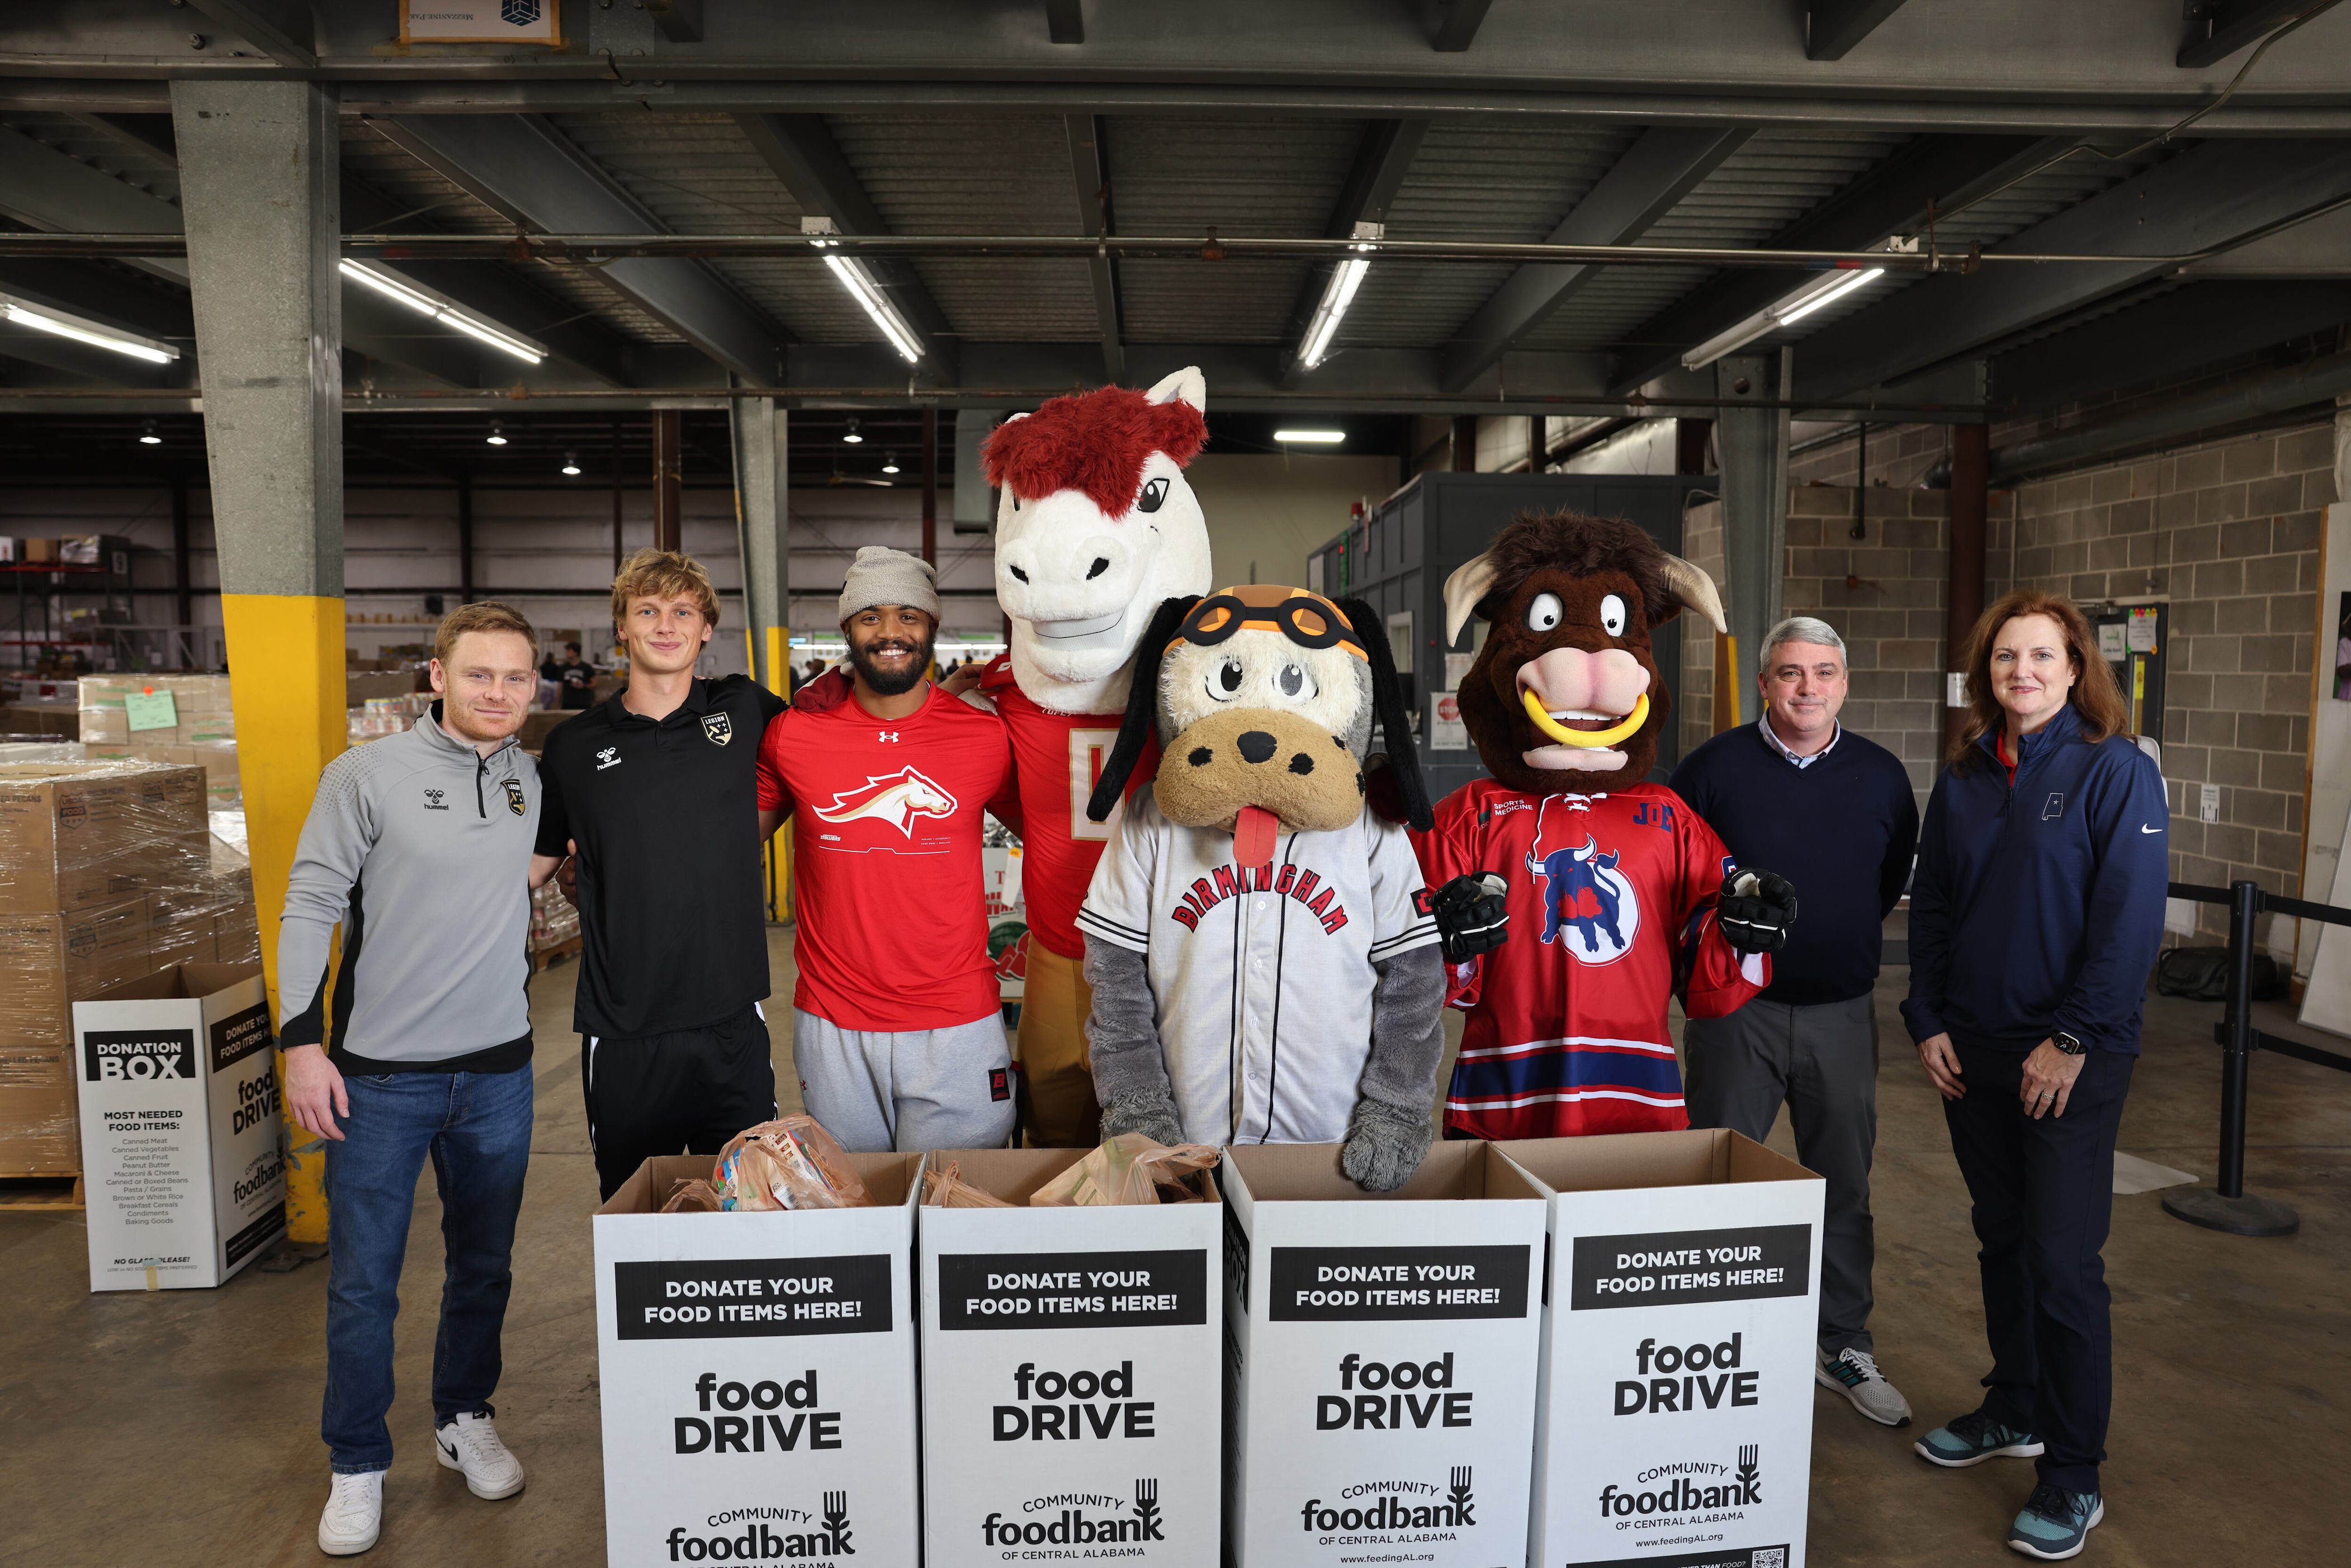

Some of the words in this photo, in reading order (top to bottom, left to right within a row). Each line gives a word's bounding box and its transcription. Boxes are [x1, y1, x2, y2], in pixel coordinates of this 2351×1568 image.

[705, 716, 725, 725] LEGION
[597, 757, 622, 771] hummel
[62, 808, 83, 817] FOOD
[1493, 799, 1525, 809] SPORTS
[1494, 804, 1533, 816] MEDICINE
[1633, 802, 1674, 833] JOE
[1171, 860, 1349, 936] BIRMINGHAM
[226, 1018, 255, 1040] DONATE
[97, 1041, 182, 1055] DONATION
[220, 1041, 242, 1059] FOOD
[242, 1031, 263, 1049] ITEMS
[99, 1054, 183, 1081] BOX
[238, 1065, 273, 1106] food
[993, 1073, 1005, 1088] B
[104, 1111, 135, 1120] MOST
[138, 1110, 183, 1119] NEEDED
[233, 1087, 281, 1135] DRIVE
[108, 1123, 140, 1131] FOOD
[233, 1159, 287, 1204] foodbank
[1617, 1249, 1701, 1269] DONATE
[1706, 1246, 1762, 1264] YOUR
[987, 1272, 1081, 1290] DONATE
[1086, 1271, 1151, 1287] YOUR
[1318, 1265, 1409, 1282] DONATE
[1415, 1264, 1476, 1281] YOUR
[1596, 1276, 1655, 1294] FOOD
[1661, 1272, 1721, 1291] ITEMS
[1726, 1268, 1784, 1286] HERE!
[665, 1279, 763, 1298] DONATE
[767, 1277, 834, 1296] YOUR
[1296, 1290, 1360, 1306] FOOD
[1366, 1289, 1431, 1306] ITEMS
[1437, 1288, 1500, 1305] HERE!
[644, 1305, 712, 1324] FOOD
[718, 1304, 788, 1322] ITEMS
[794, 1301, 862, 1320] HERE!
[966, 1297, 1032, 1315] FOOD
[1038, 1296, 1105, 1314] ITEMS
[1111, 1294, 1177, 1311] HERE!
[1636, 1332, 1742, 1375] food
[1014, 1360, 1133, 1400] food
[1339, 1352, 1454, 1390] food
[695, 1369, 818, 1412] food
[1614, 1371, 1759, 1416] DRIVE
[993, 1401, 1155, 1442] DRIVE
[1316, 1392, 1473, 1430] DRIVE
[674, 1411, 842, 1455] DRIVE
[1637, 1462, 1729, 1483] COMMUNITY
[1341, 1480, 1440, 1499] COMMUNITY
[1599, 1472, 1762, 1518] foodbank
[1023, 1493, 1125, 1513] COMMUNITY
[1300, 1494, 1477, 1532] foodbank
[707, 1507, 813, 1528] COMMUNITY
[982, 1507, 1165, 1546] foodbank
[1616, 1521, 1631, 1531] OF
[1634, 1517, 1686, 1529] CENTRAL
[1689, 1512, 1744, 1524] ALABAMA
[666, 1520, 856, 1562] foodbank
[1319, 1537, 1335, 1546] OF
[1338, 1535, 1394, 1545] CENTRAL
[1397, 1532, 1457, 1543] ALABAMA
[1636, 1533, 1723, 1547] www.feedingAL.org
[1001, 1551, 1019, 1561] OF
[1022, 1550, 1079, 1560] CENTRAL
[1083, 1547, 1145, 1559] ALABAMA
[1340, 1553, 1434, 1564] www.feedingAL.org
